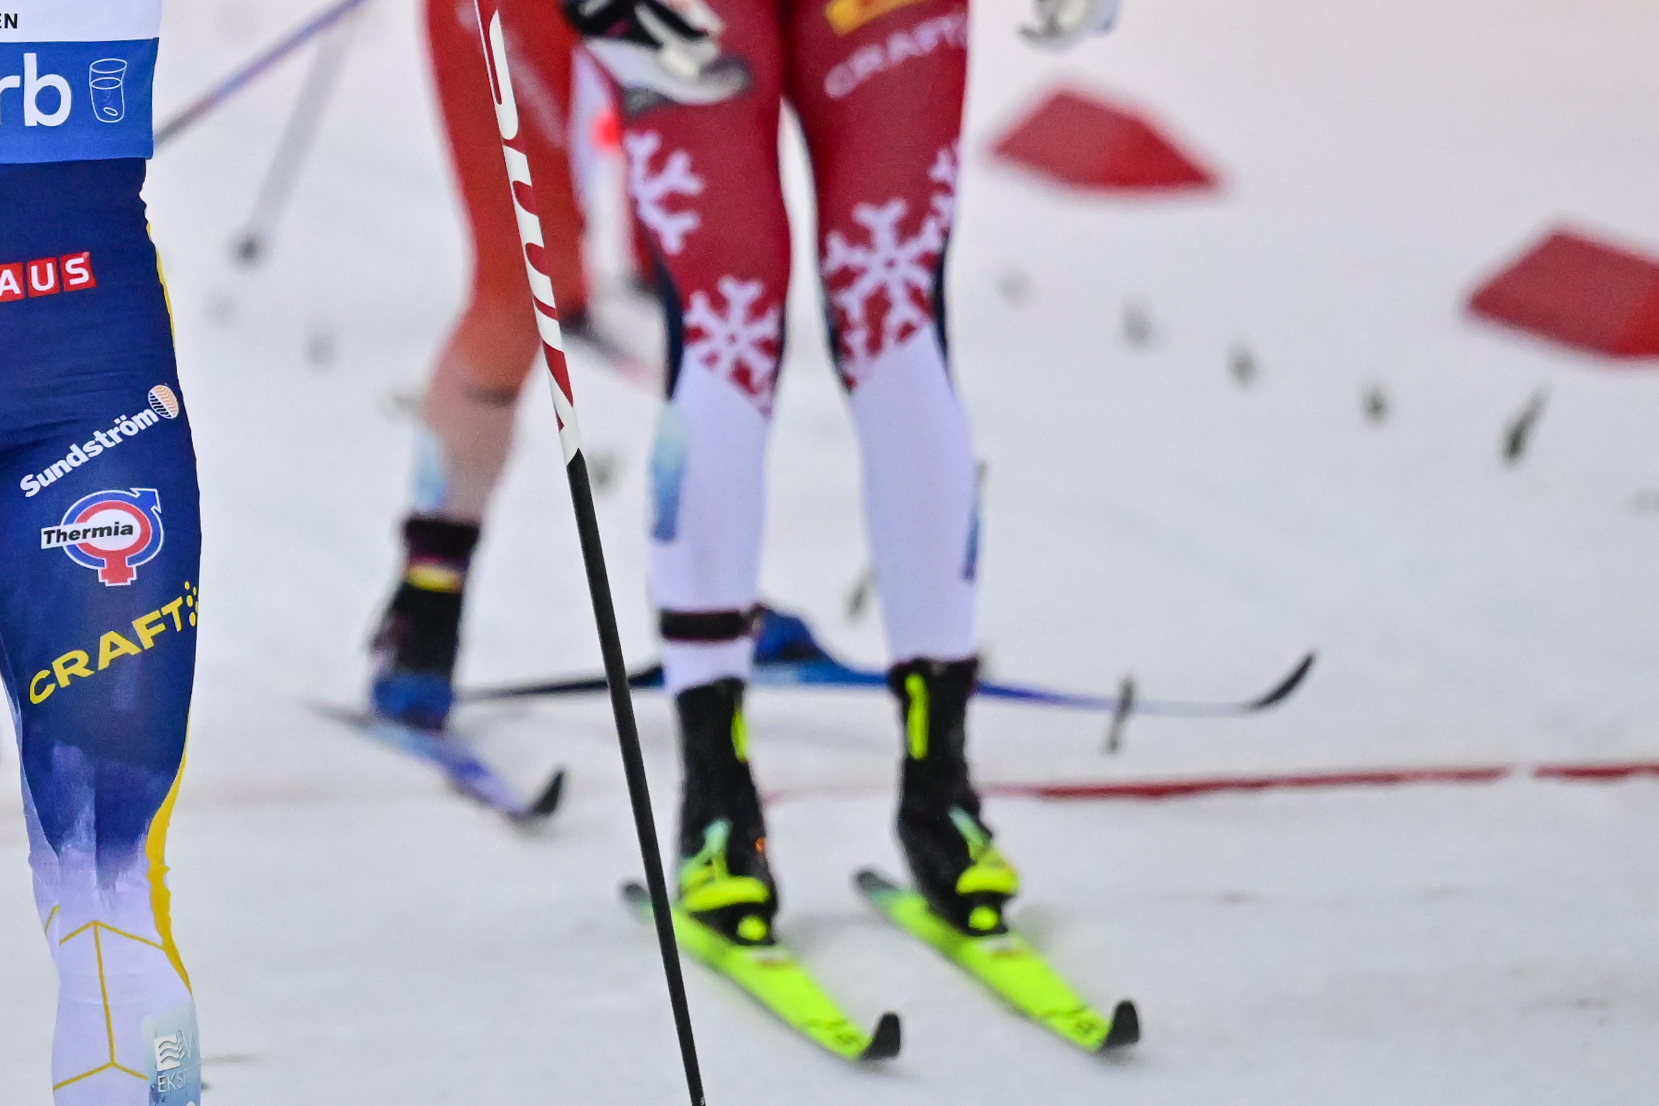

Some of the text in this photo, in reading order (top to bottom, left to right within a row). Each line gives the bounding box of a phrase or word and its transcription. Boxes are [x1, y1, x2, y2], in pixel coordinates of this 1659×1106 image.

[20, 407, 159, 498] Sundström
[43, 521, 134, 545] Thermia
[29, 596, 183, 705] CRAFT
